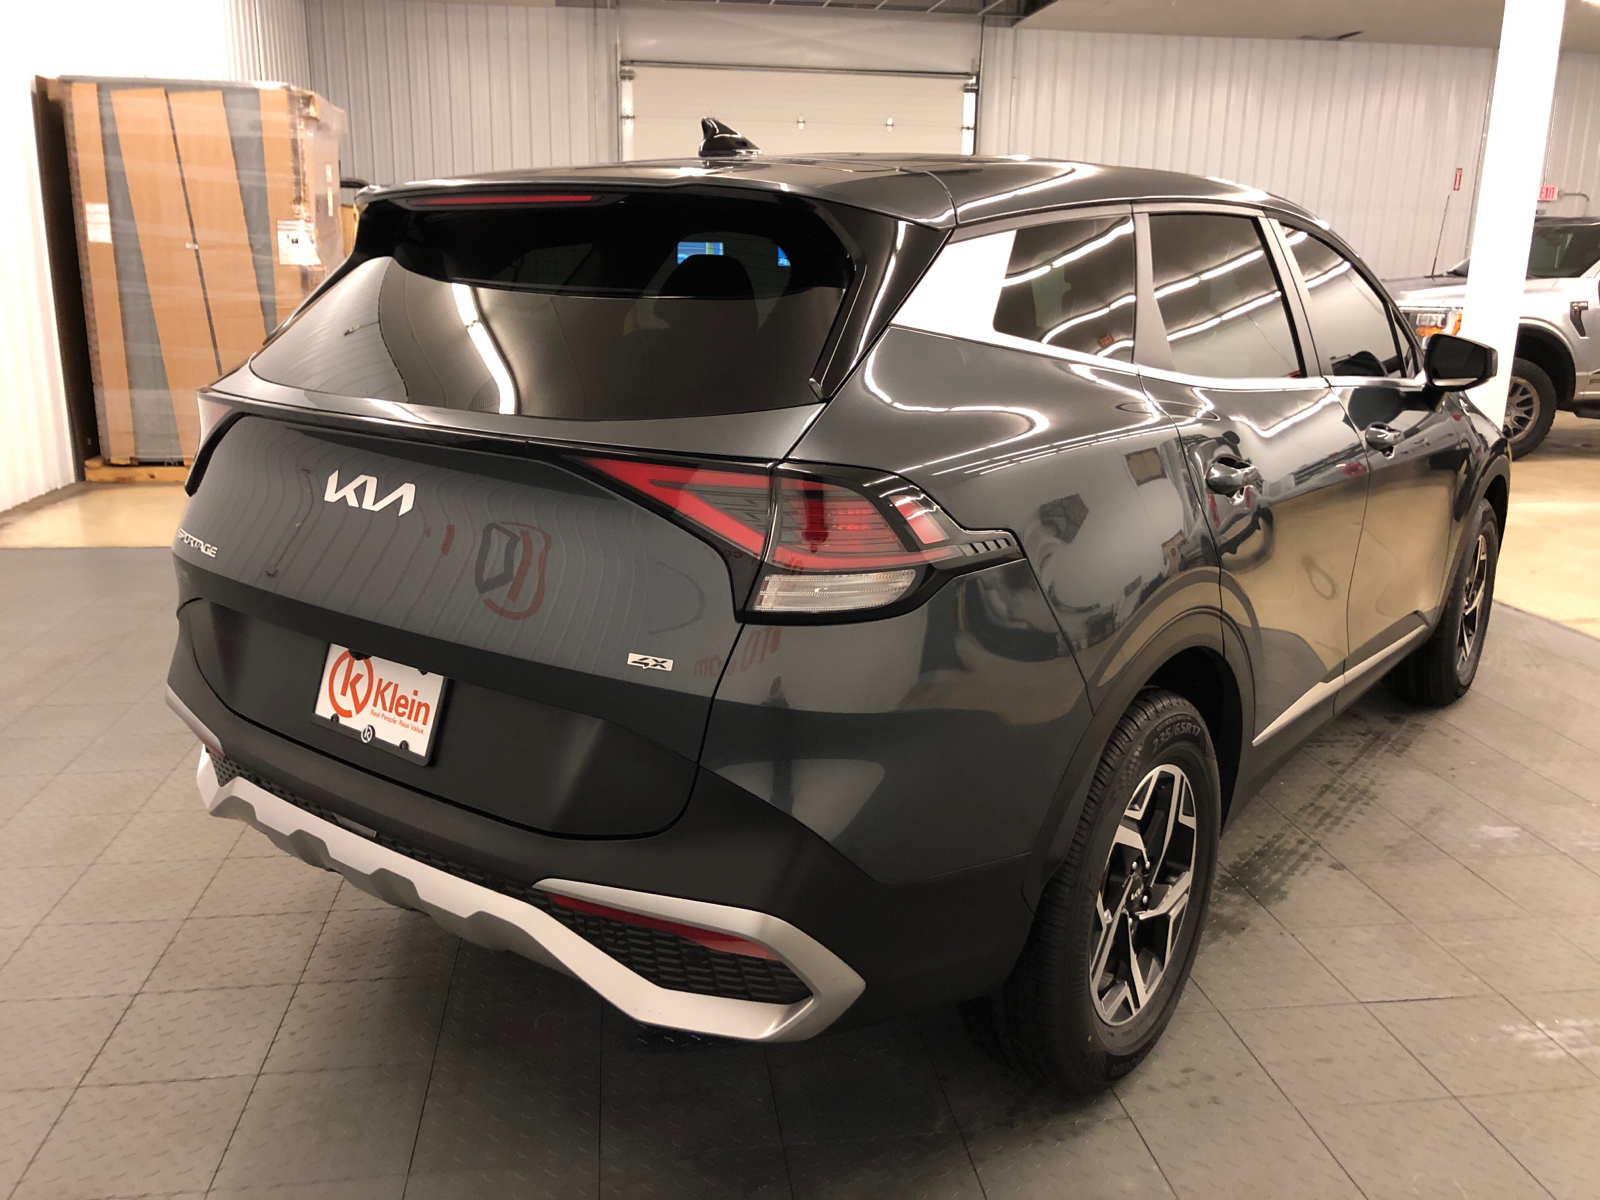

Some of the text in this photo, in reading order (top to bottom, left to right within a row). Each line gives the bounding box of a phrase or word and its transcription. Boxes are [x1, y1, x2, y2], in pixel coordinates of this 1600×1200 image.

[1540, 187, 1556, 200] EXIT
[324, 469, 416, 517] KIA
[372, 677, 430, 726] Klein
[370, 709, 425, 734] Real People. Real Value.
[1152, 722, 1201, 755] 235/65R17
